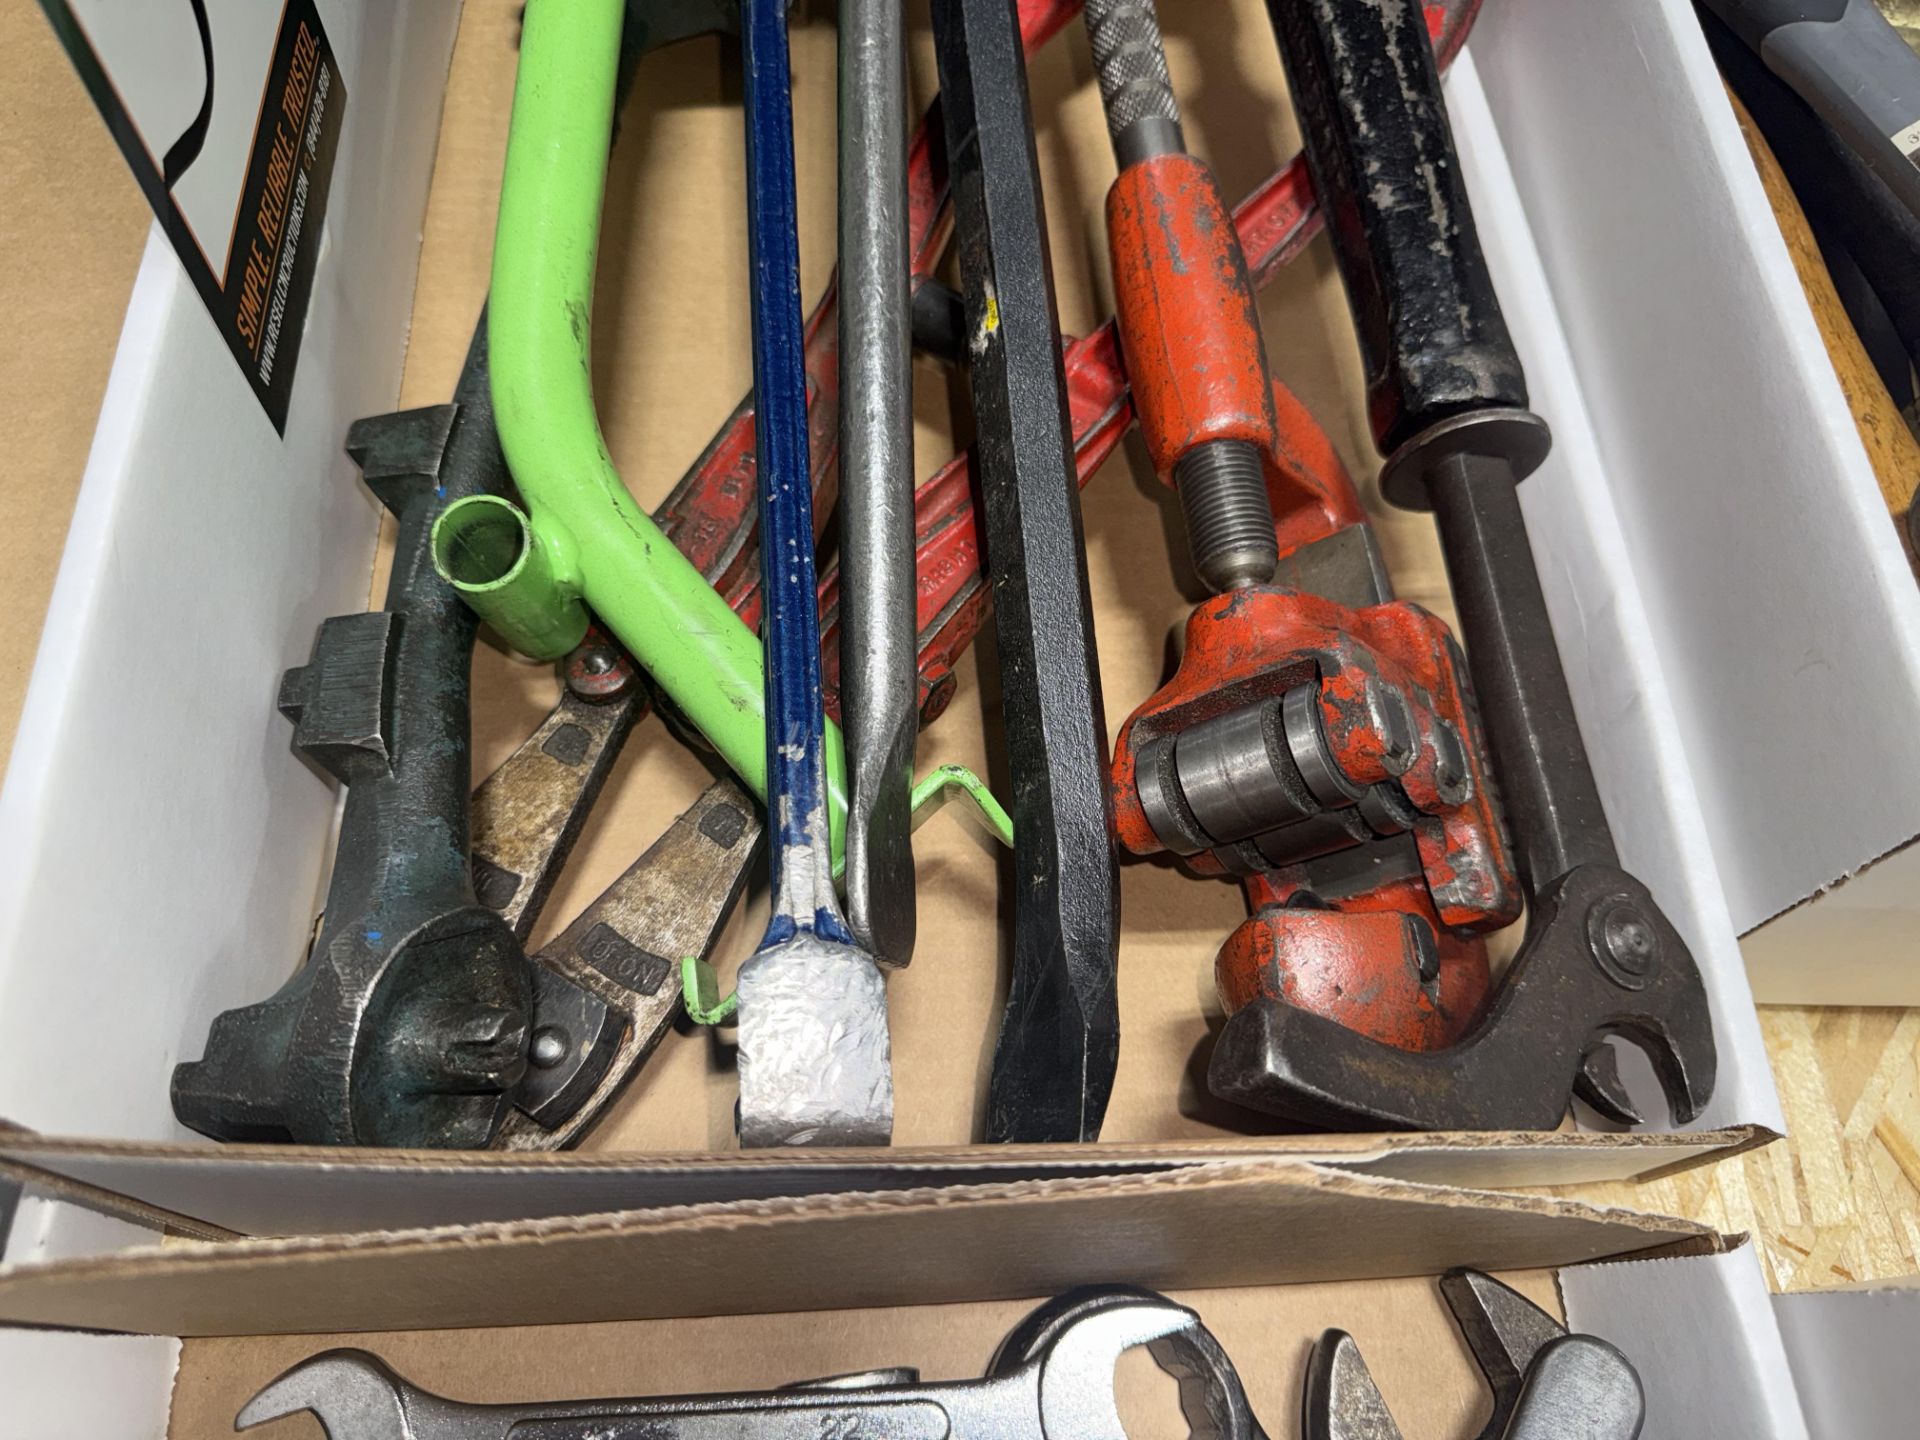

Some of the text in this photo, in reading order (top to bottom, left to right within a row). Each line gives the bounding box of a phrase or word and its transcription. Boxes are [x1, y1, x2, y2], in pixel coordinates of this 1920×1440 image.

[236, 238, 271, 350] SIMPLE.
[257, 121, 295, 250] RELIABLE.
[259, 167, 310, 387] WWW.RESELLCNCAUCTIONS.COM
[820, 1412, 861, 1440] 22
